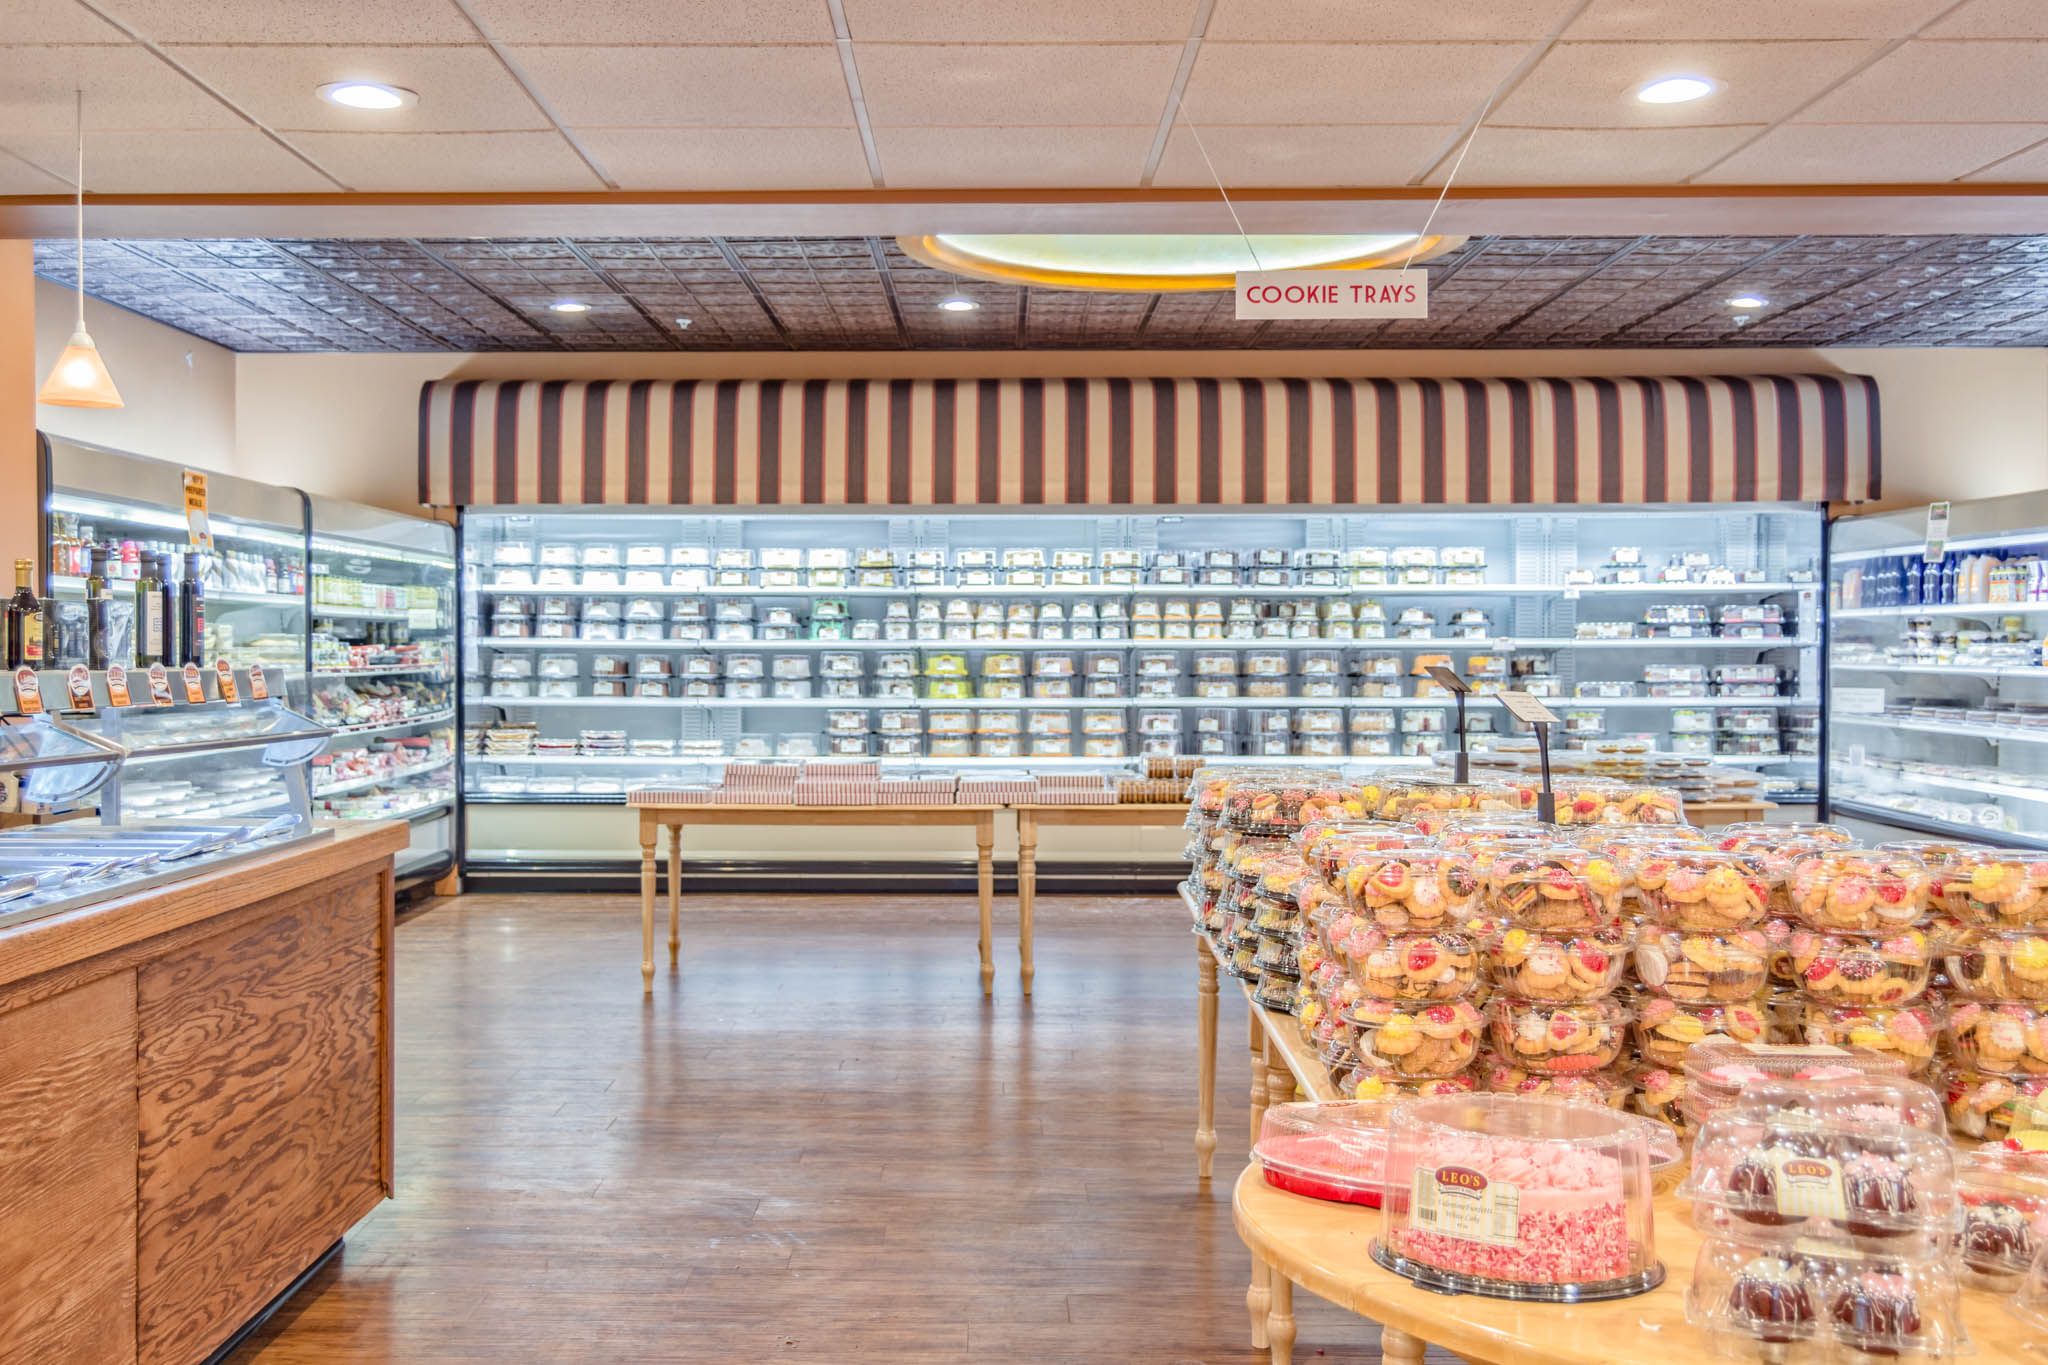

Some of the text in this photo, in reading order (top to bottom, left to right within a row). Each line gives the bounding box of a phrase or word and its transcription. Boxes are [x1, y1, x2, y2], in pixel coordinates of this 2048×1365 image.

[1246, 285, 1416, 303] COOKIE TRAYS
[1442, 1170, 1481, 1187] LEO'S
[1789, 1164, 1827, 1176] LEO'S
